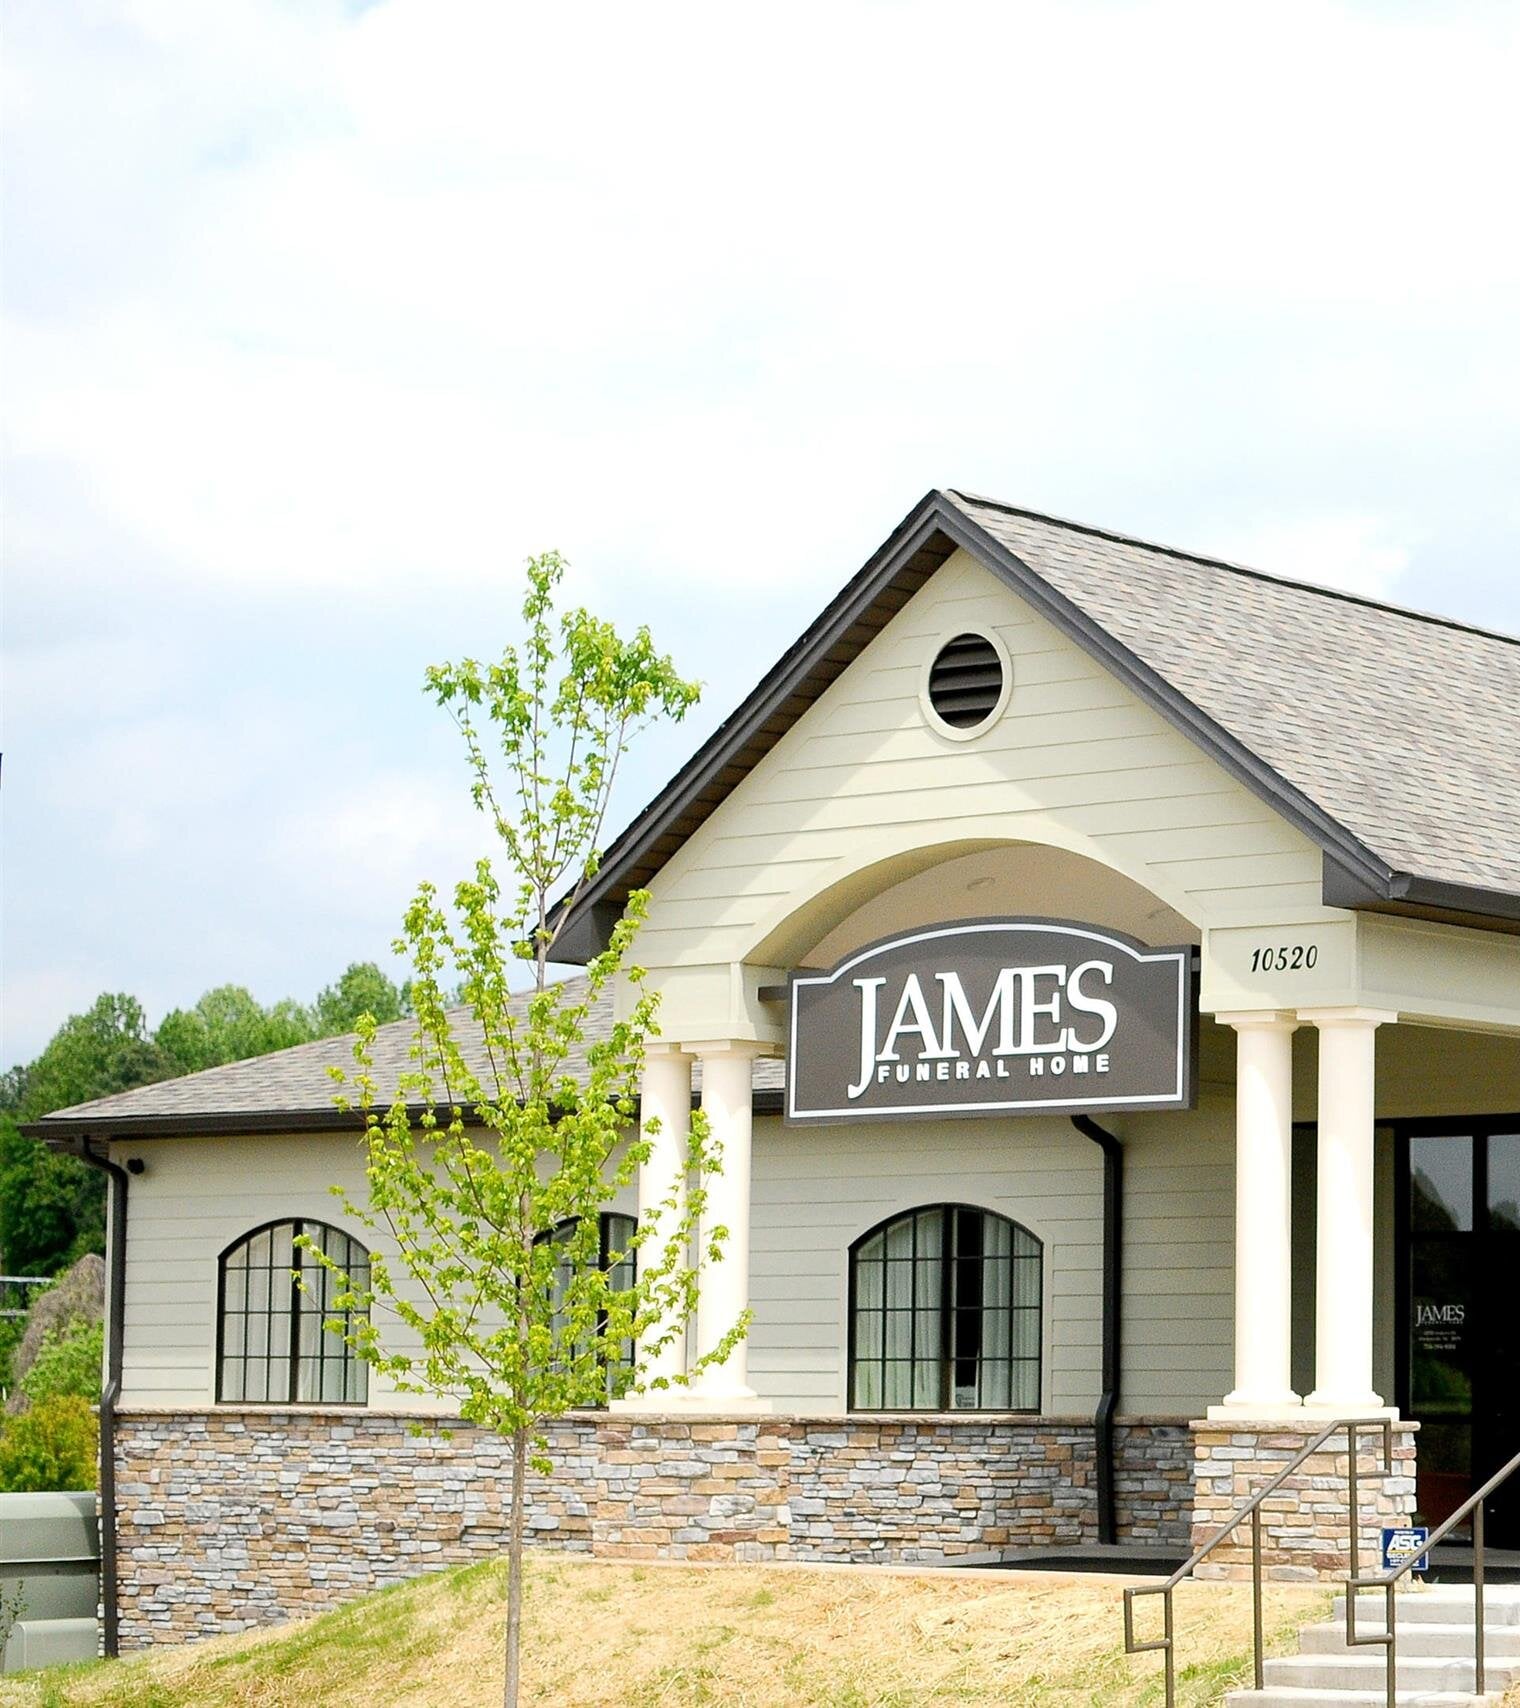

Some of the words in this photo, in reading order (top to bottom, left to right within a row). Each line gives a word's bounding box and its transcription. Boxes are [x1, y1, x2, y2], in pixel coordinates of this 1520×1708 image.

[1251, 945, 1319, 973] 10520
[847, 960, 1118, 1099] JAMES
[877, 1059, 1010, 1083] FUNERAL
[1029, 1053, 1110, 1076] HOME
[1415, 1304, 1465, 1327] JAMES
